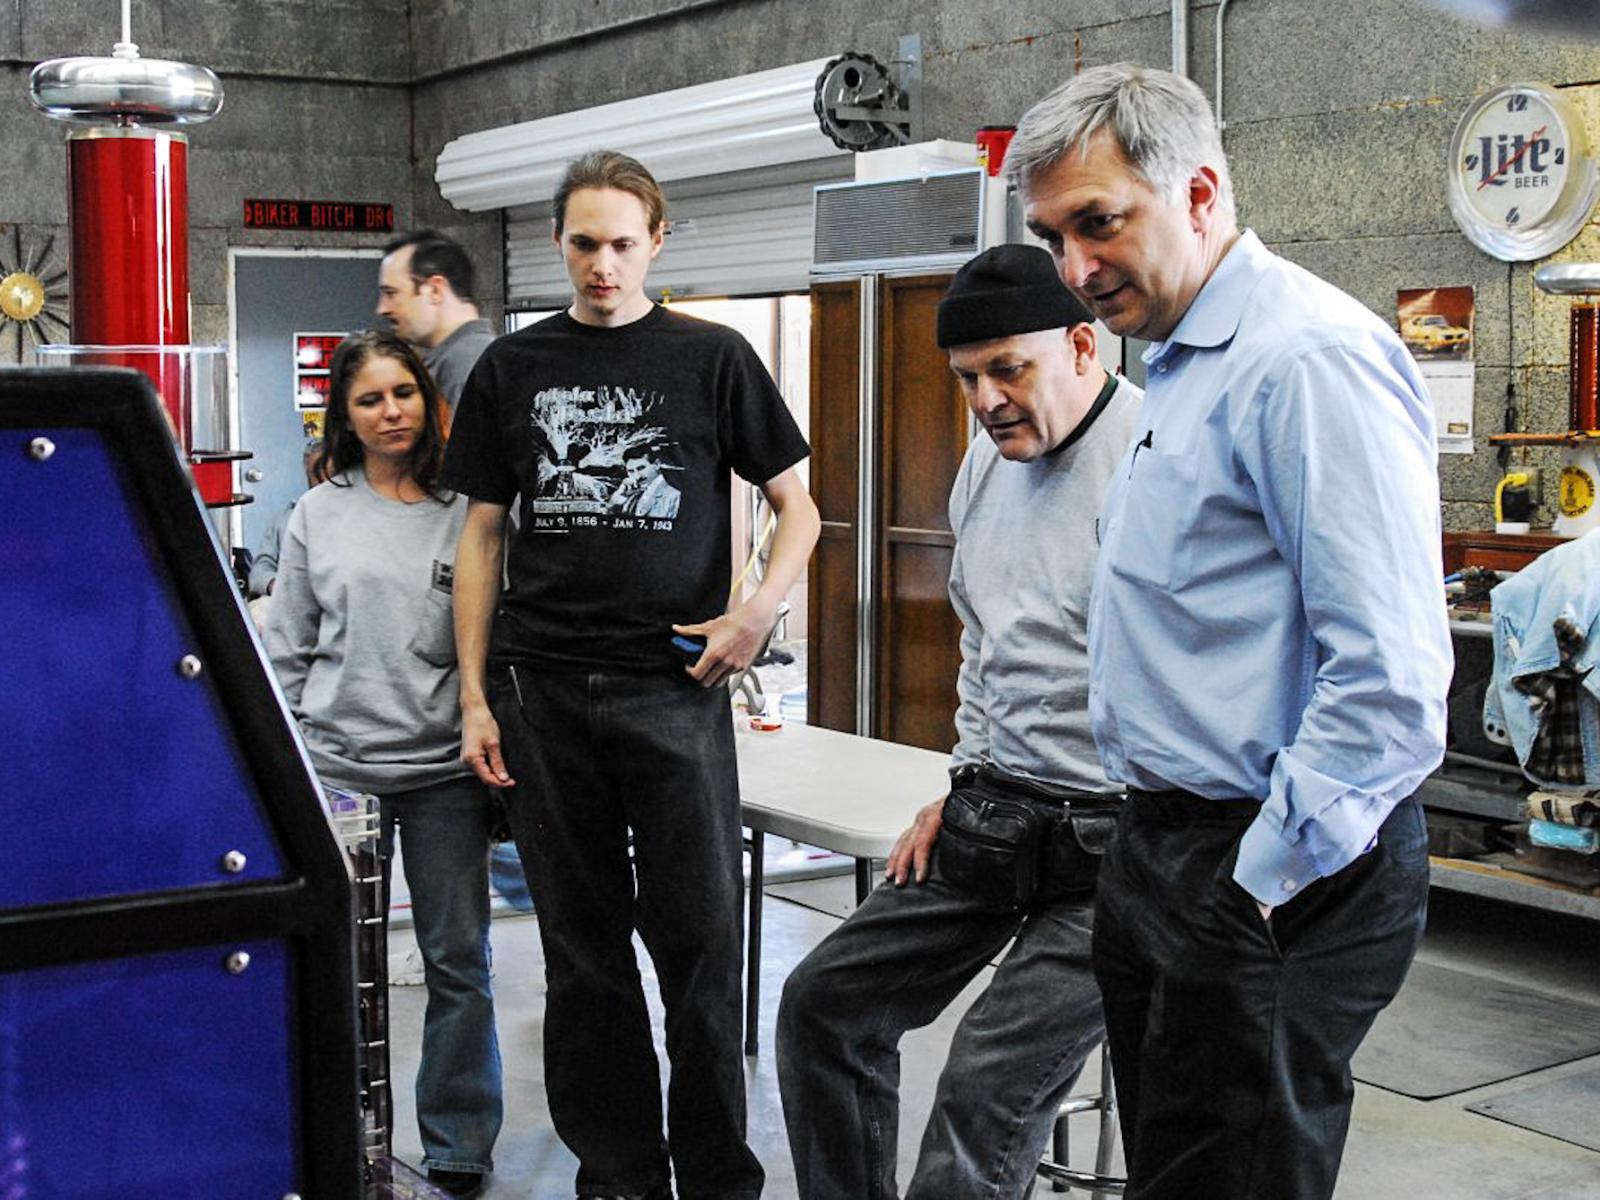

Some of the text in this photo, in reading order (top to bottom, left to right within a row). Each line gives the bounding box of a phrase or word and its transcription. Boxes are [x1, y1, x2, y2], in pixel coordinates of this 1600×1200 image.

[1507, 94, 1528, 112] 12
[1478, 134, 1551, 187] Lite
[1515, 175, 1549, 188] BEER
[255, 202, 299, 225] BIKER
[312, 203, 354, 227] BITCH
[535, 517, 554, 527] JULY
[572, 516, 598, 526] 1856
[612, 518, 633, 528] JAN
